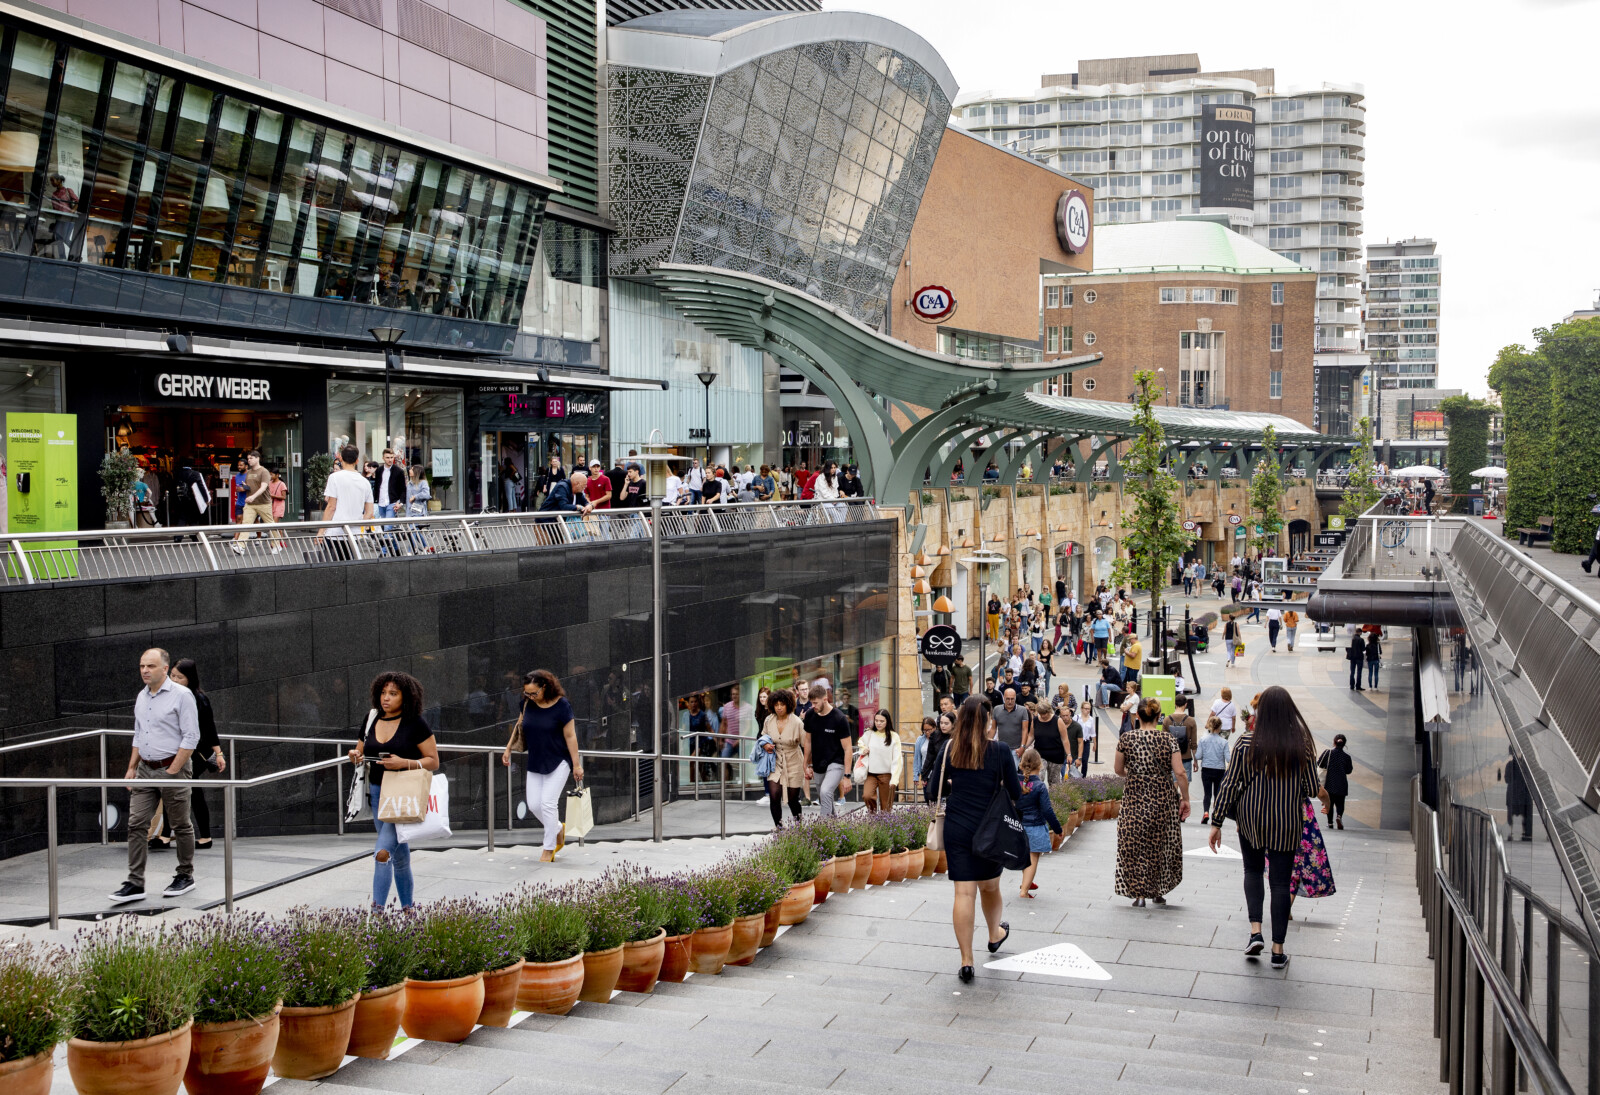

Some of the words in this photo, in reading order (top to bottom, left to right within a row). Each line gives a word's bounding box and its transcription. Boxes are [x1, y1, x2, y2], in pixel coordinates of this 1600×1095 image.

[1219, 110, 1251, 121] FORUM
[1206, 130, 1231, 144] on
[1235, 128, 1255, 149] top
[1208, 141, 1232, 160] of
[1233, 144, 1254, 163] the
[1219, 159, 1248, 181] city
[1068, 205, 1087, 238] C&A
[919, 294, 946, 310] C&A
[157, 373, 214, 398] GERRY
[216, 376, 271, 401] WEBER
[571, 402, 595, 414] HUAWEI
[688, 428, 712, 440] ZARA
[1319, 537, 1336, 545] WE
[377, 795, 420, 818] ZARA
